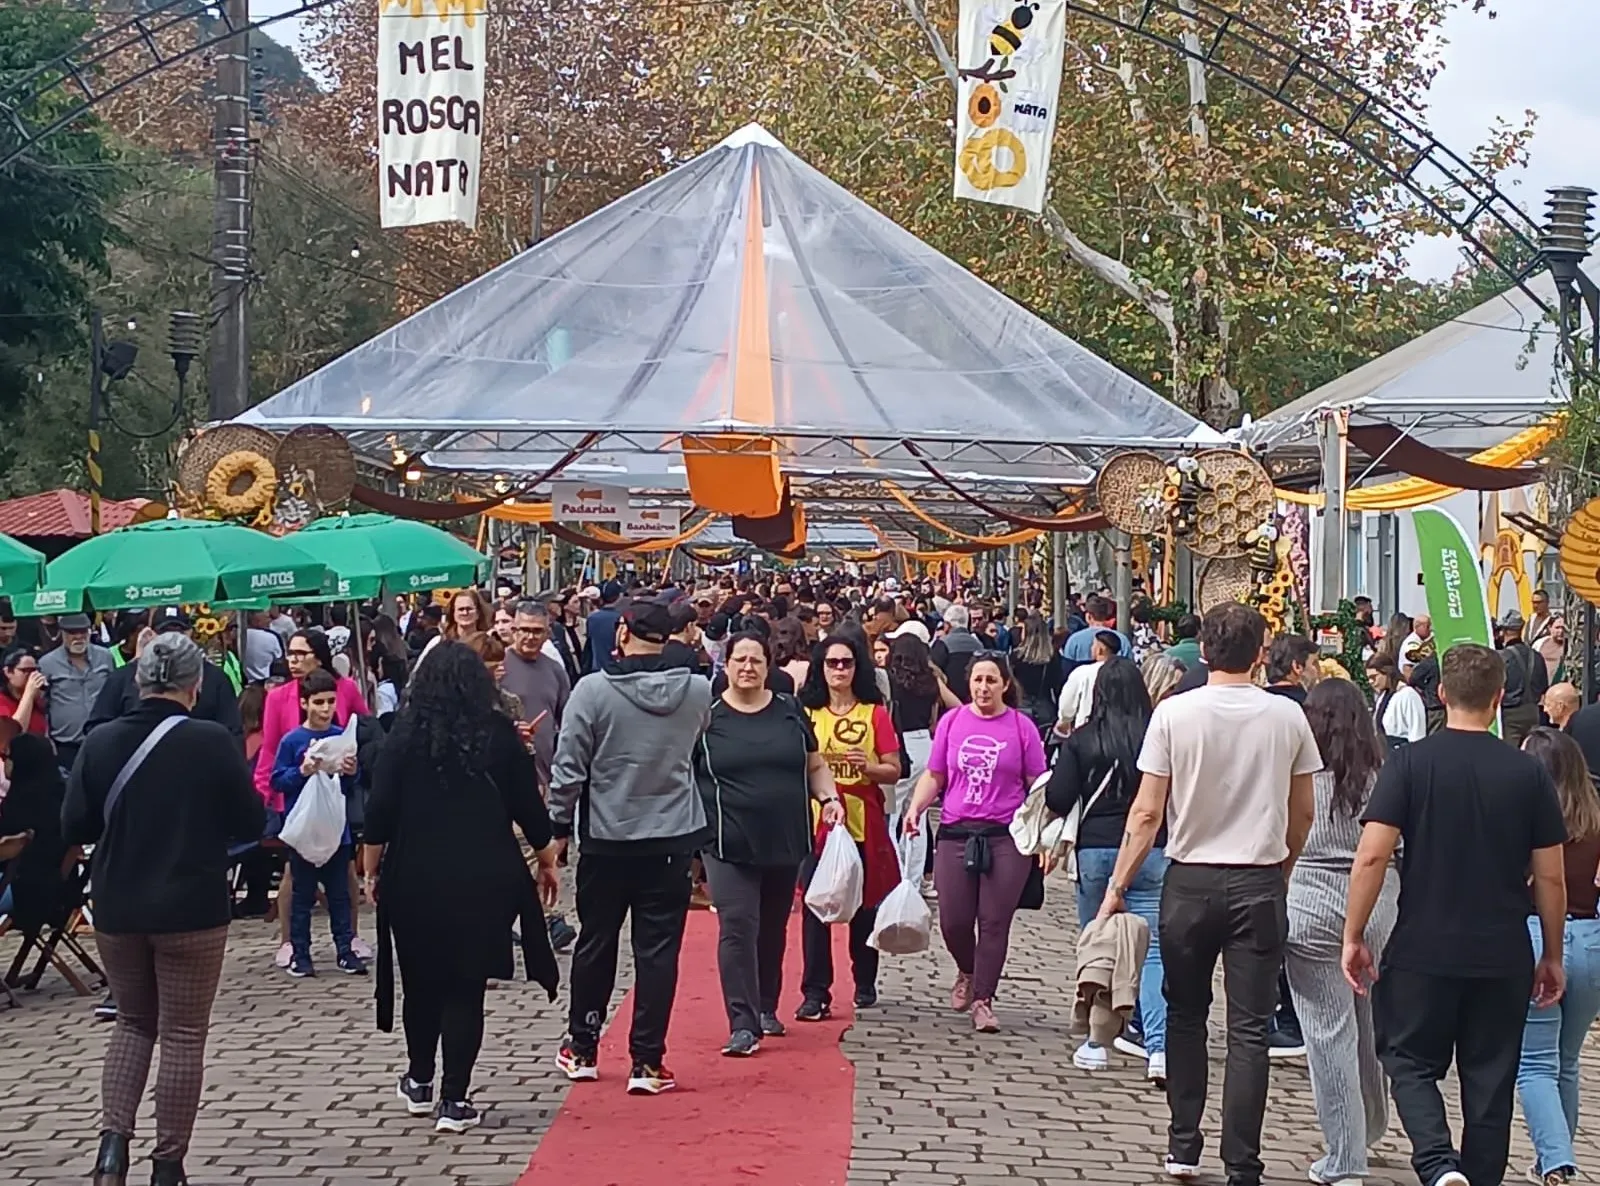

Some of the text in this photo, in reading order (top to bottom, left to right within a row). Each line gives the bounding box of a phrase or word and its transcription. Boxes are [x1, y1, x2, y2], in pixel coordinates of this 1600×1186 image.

[398, 35, 474, 75] MEL
[382, 95, 480, 135] ROSCA
[1014, 103, 1047, 119] NATA
[387, 158, 469, 198] NATA
[562, 503, 616, 514] Padarias
[251, 571, 295, 588] JUNTOS
[141, 584, 183, 598] Sicredi
